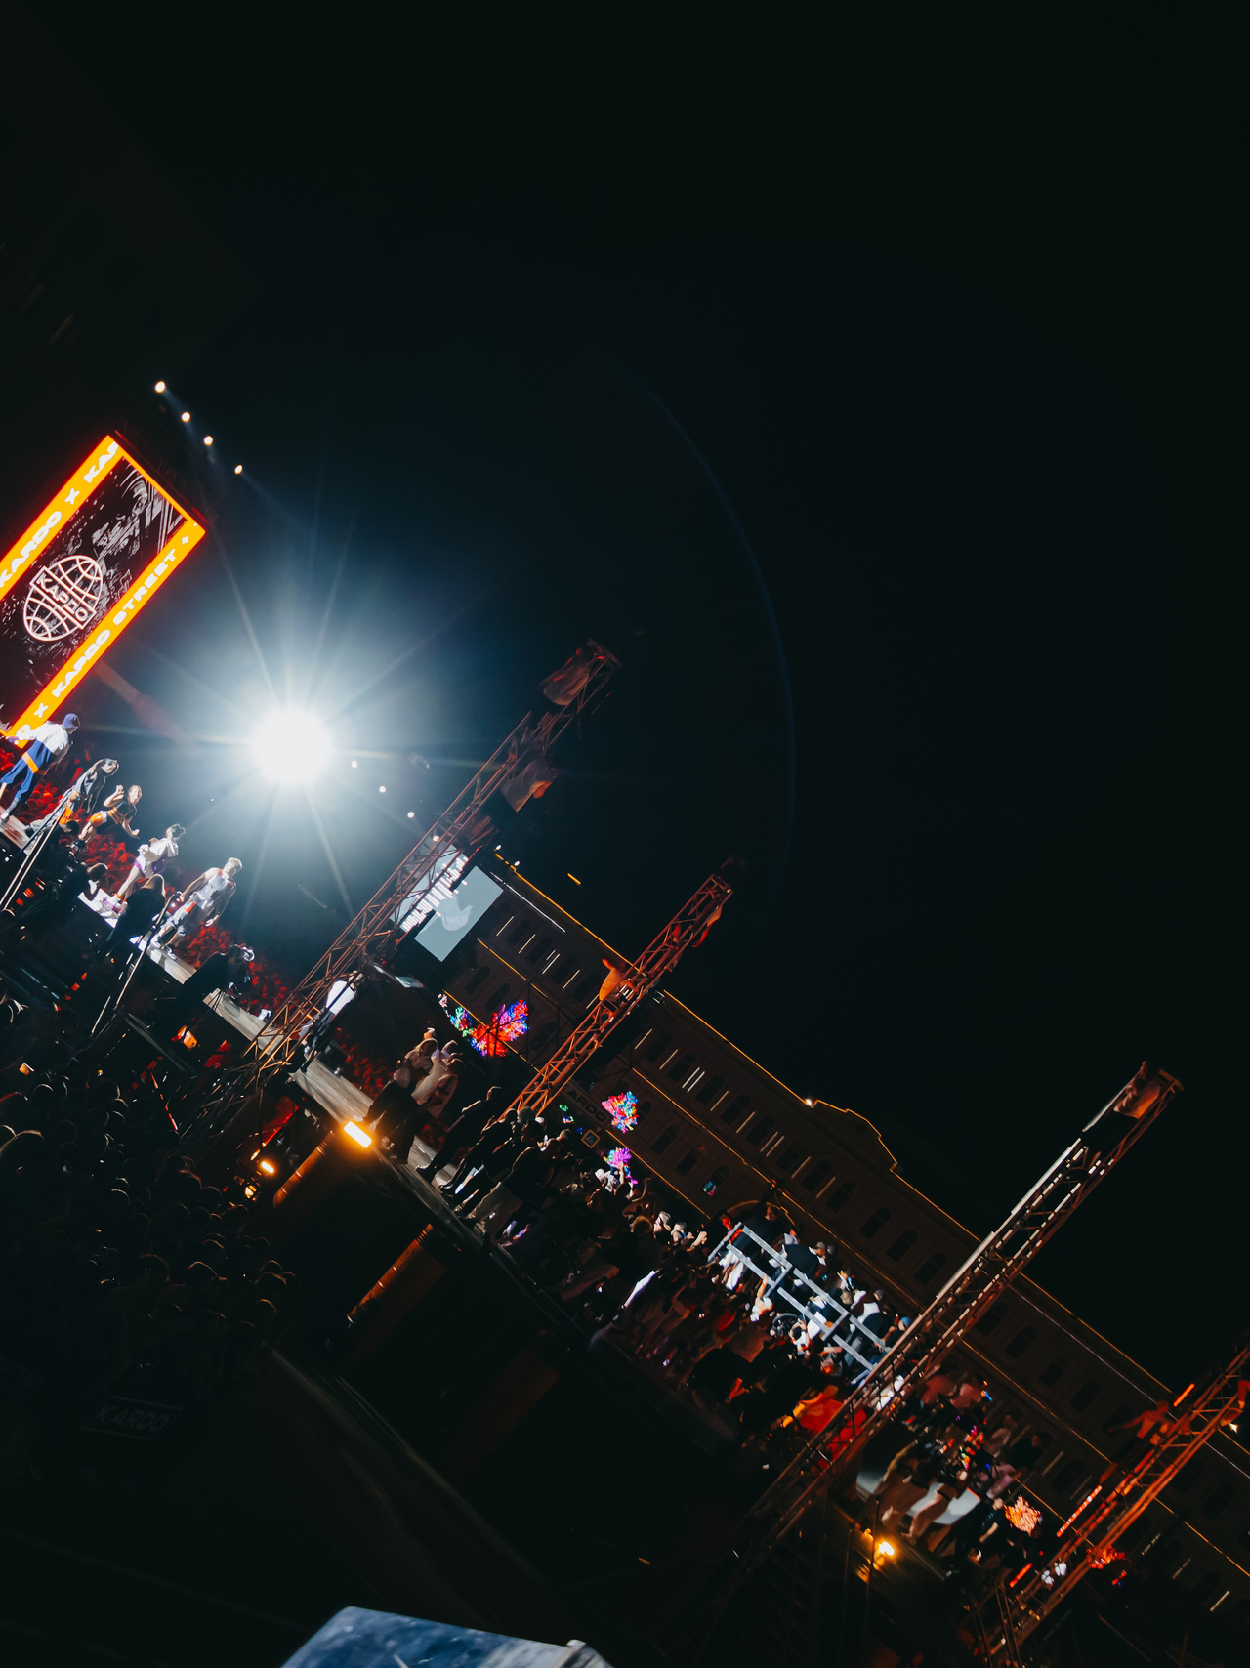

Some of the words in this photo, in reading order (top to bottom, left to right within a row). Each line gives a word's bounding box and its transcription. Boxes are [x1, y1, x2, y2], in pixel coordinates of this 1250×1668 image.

[36, 572, 89, 622] КАРДО
[113, 549, 177, 625] STREET
[563, 1083, 606, 1122] ARDO
[92, 1404, 170, 1432] KARDO
